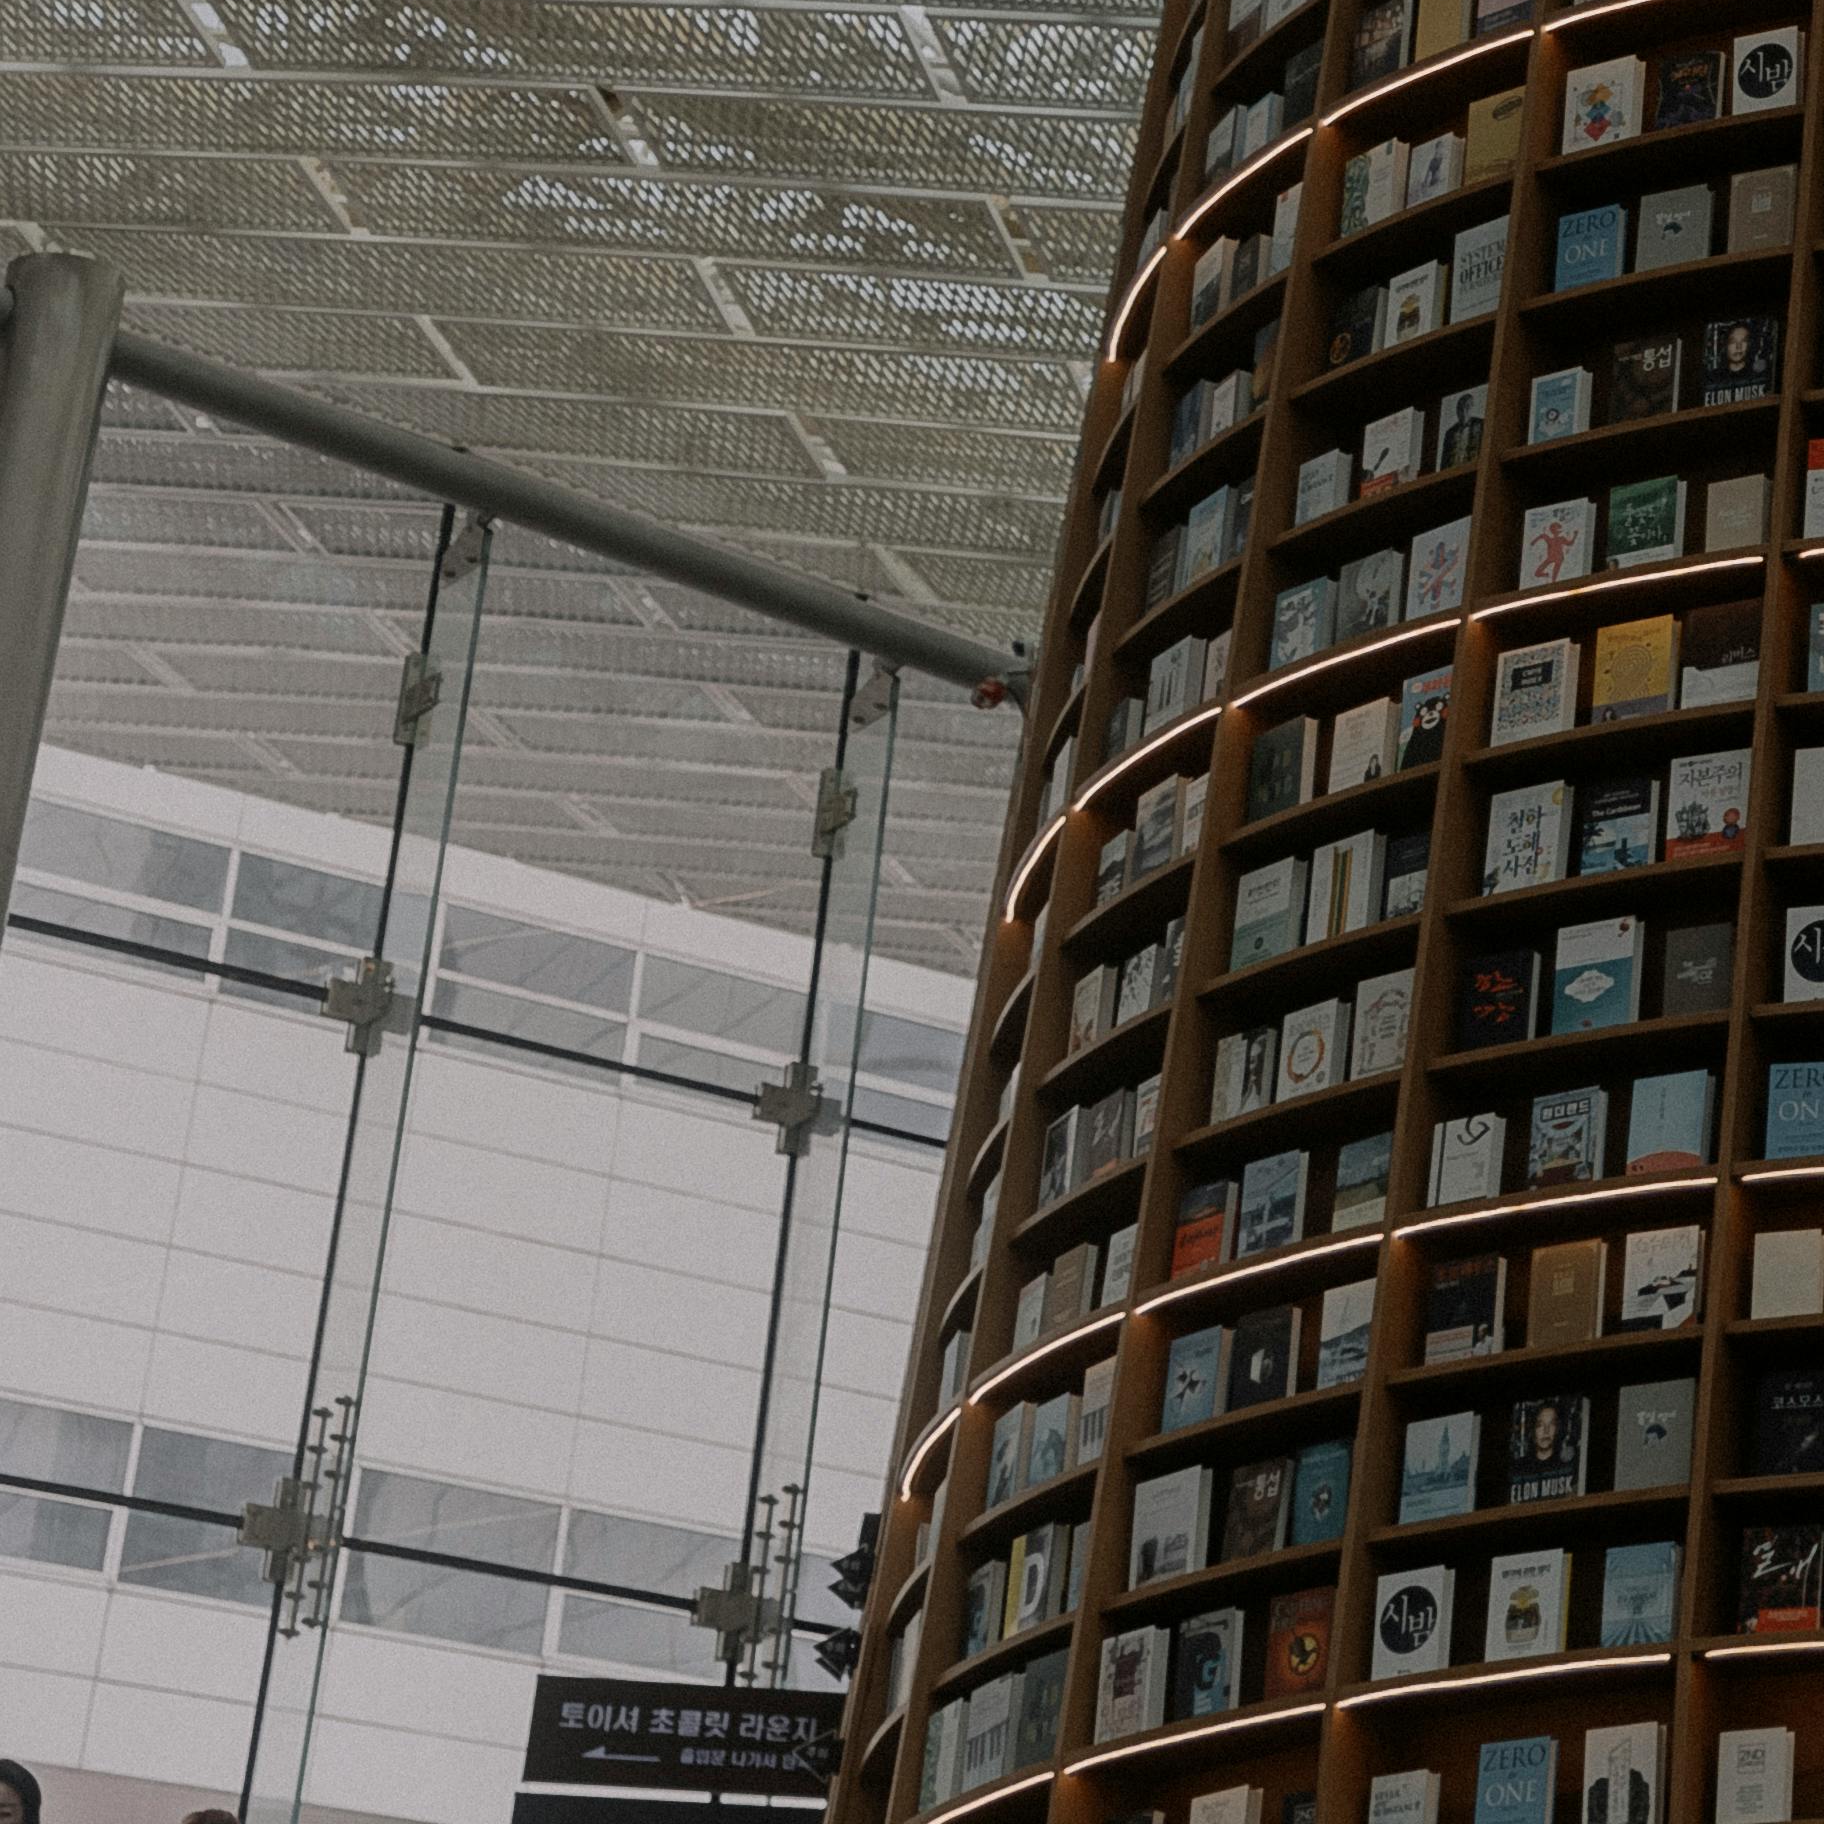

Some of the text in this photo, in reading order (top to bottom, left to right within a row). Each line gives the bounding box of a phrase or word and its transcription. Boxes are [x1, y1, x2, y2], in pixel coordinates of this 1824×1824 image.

[1740, 49, 1793, 93] 시밤
[1562, 210, 1617, 239] ZERO
[1564, 238, 1608, 265] ONE
[1642, 344, 1672, 371] 통섭
[1704, 383, 1769, 407] ELON MUSK
[1510, 1475, 1574, 1504] ELON MUSK
[1381, 1594, 1434, 1648] 시밤
[559, 1701, 818, 1744] 토이셔 초콜릿 라운지
[1483, 1743, 1547, 1773] ZERO
[1485, 1778, 1538, 1808] ONE
